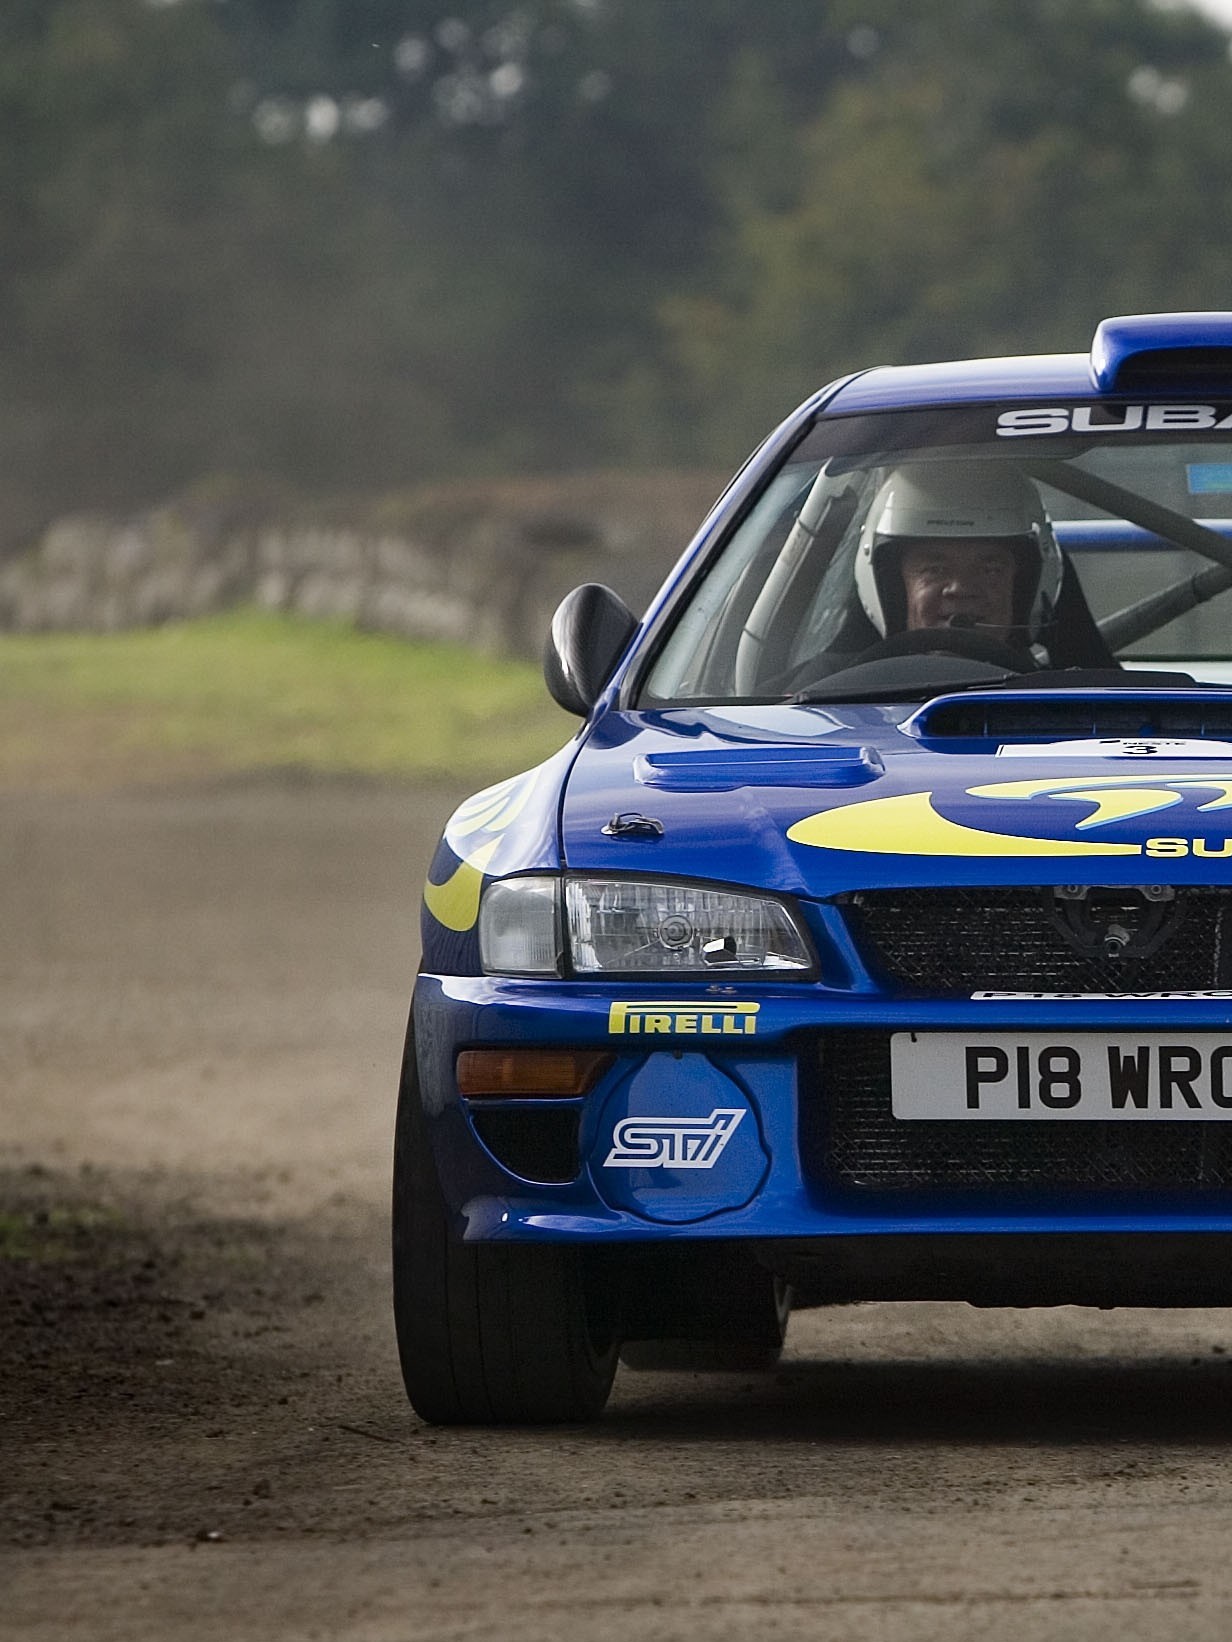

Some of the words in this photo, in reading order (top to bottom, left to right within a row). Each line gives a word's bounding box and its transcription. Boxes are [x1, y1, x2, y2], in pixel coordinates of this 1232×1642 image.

[1122, 745, 1158, 755] 3
[608, 1001, 761, 1035] PIRELLI
[964, 1046, 1082, 1109] P18
